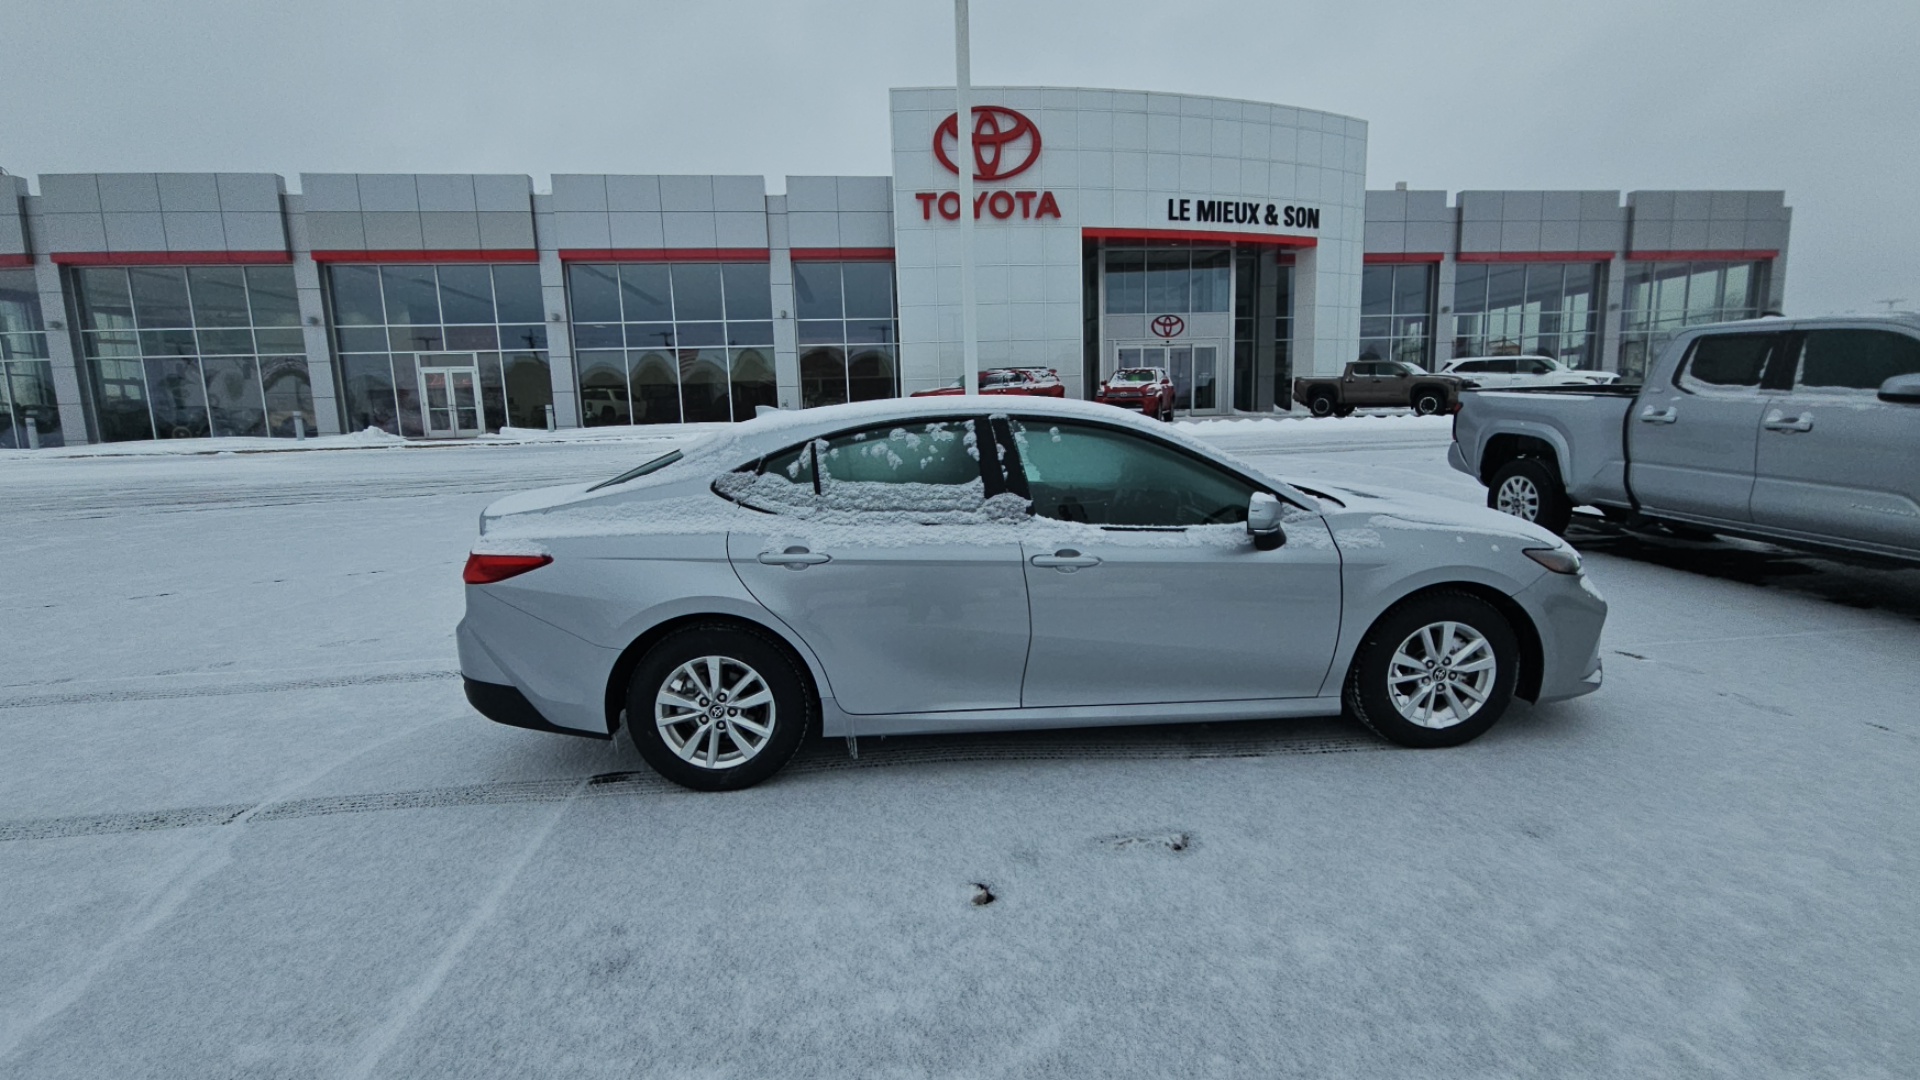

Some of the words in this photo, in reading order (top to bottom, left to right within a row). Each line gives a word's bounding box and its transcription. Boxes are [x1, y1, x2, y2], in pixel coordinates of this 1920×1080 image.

[915, 190, 1062, 221] TOYOTA
[1168, 199, 1190, 221] LE
[1197, 200, 1260, 225] MIEUX
[1264, 204, 1279, 226] &
[1284, 205, 1320, 229] SON
